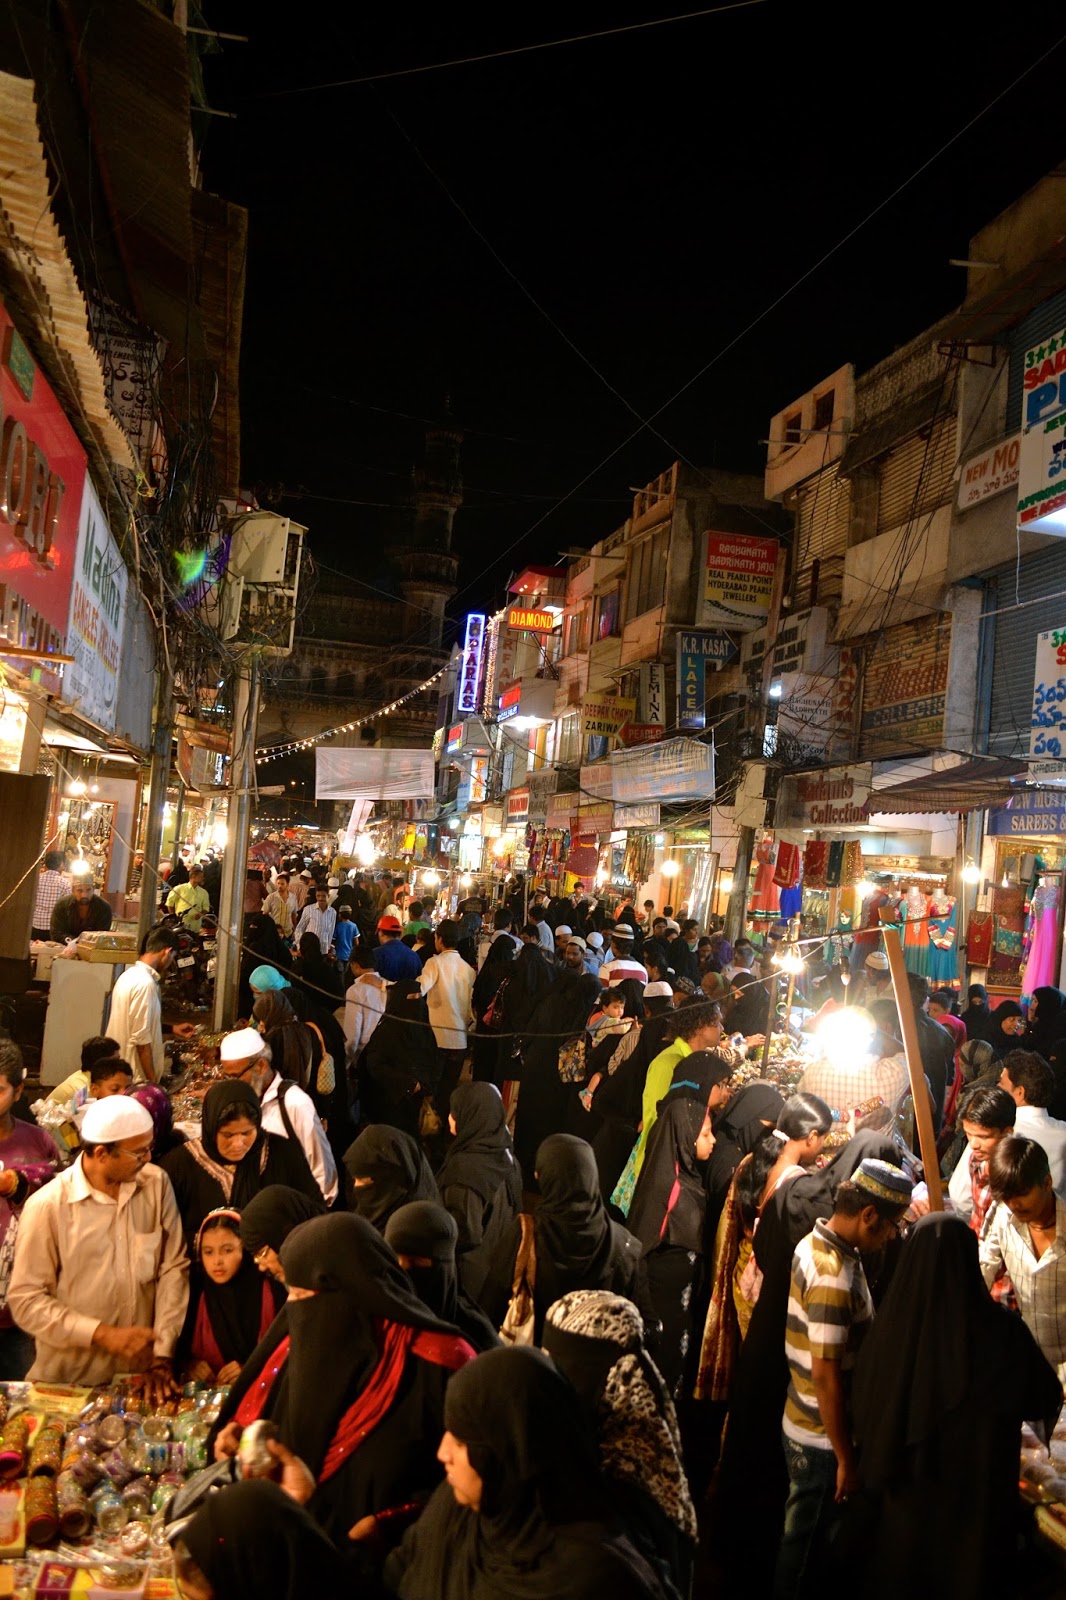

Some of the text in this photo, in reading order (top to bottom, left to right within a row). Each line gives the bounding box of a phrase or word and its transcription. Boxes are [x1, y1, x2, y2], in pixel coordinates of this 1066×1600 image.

[965, 457, 990, 485] NEW
[992, 440, 1020, 476] MO
[719, 543, 768, 558] RAGHUNATH
[82, 507, 121, 632] Madina
[709, 555, 775, 573] BADRINATH JAJU
[708, 579, 747, 592] HYDERABAD
[709, 570, 773, 585] REAL PEARLS POINT
[722, 592, 757, 603] JEWELLERS
[510, 610, 553, 629] DIAMOND
[682, 636, 699, 654] K.R.
[702, 638, 730, 657] KASAT
[462, 638, 479, 708] PARAS
[686, 656, 697, 709] LACE
[648, 665, 660, 722] FEMINA
[585, 703, 609, 719] DEEPAK
[585, 721, 619, 733] ZARIWA
[809, 802, 867, 825] Collection
[1011, 814, 1058, 831] SAREES
